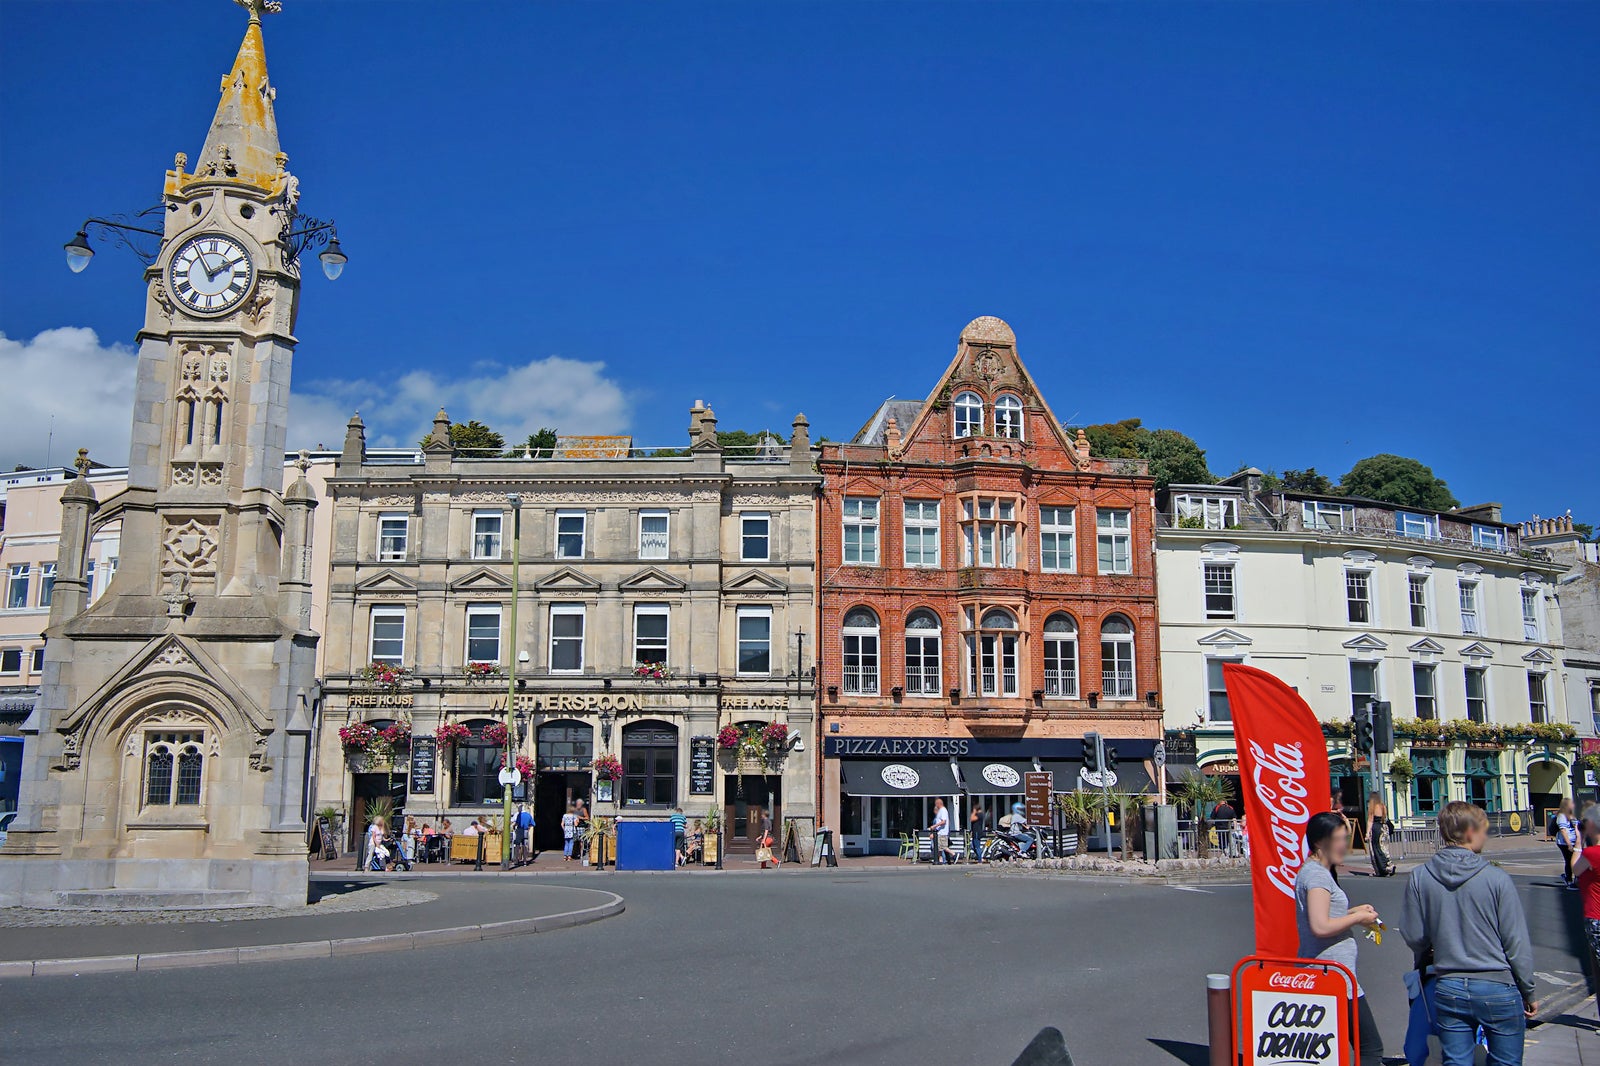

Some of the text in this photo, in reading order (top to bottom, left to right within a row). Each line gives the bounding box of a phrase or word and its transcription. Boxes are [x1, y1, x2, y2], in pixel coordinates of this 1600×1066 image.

[348, 694, 414, 706] FREE HOUSE
[721, 698, 789, 708] FREE HOUSE
[834, 738, 969, 755] PIZZAEXPRESS
[1248, 738, 1311, 900] Coca-Cola
[1269, 971, 1318, 989] Coca-Cola
[1268, 1001, 1326, 1028] COLD
[1257, 1031, 1335, 1060] DRINKS
